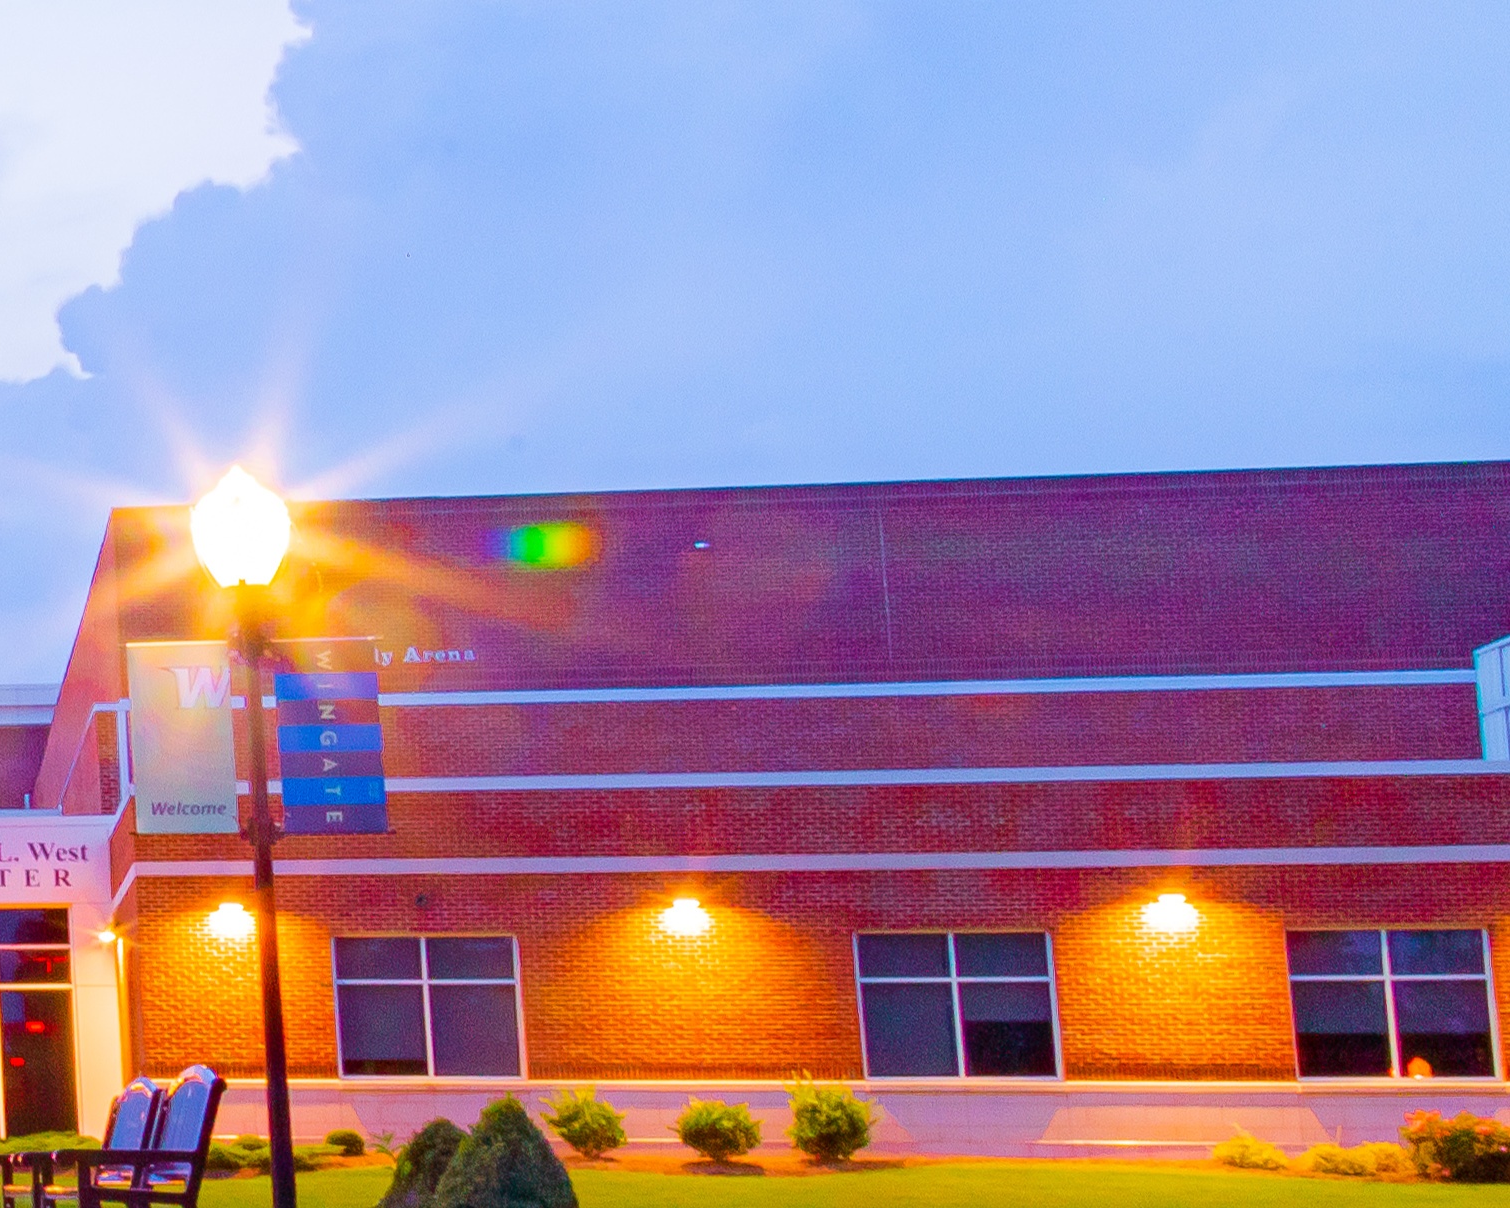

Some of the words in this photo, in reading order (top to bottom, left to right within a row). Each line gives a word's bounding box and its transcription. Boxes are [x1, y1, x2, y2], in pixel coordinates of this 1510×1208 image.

[403, 646, 476, 664] Arena
[158, 666, 231, 709] W
[316, 650, 344, 823] WINGATE
[151, 801, 227, 816] Welcome
[27, 841, 89, 862] West
